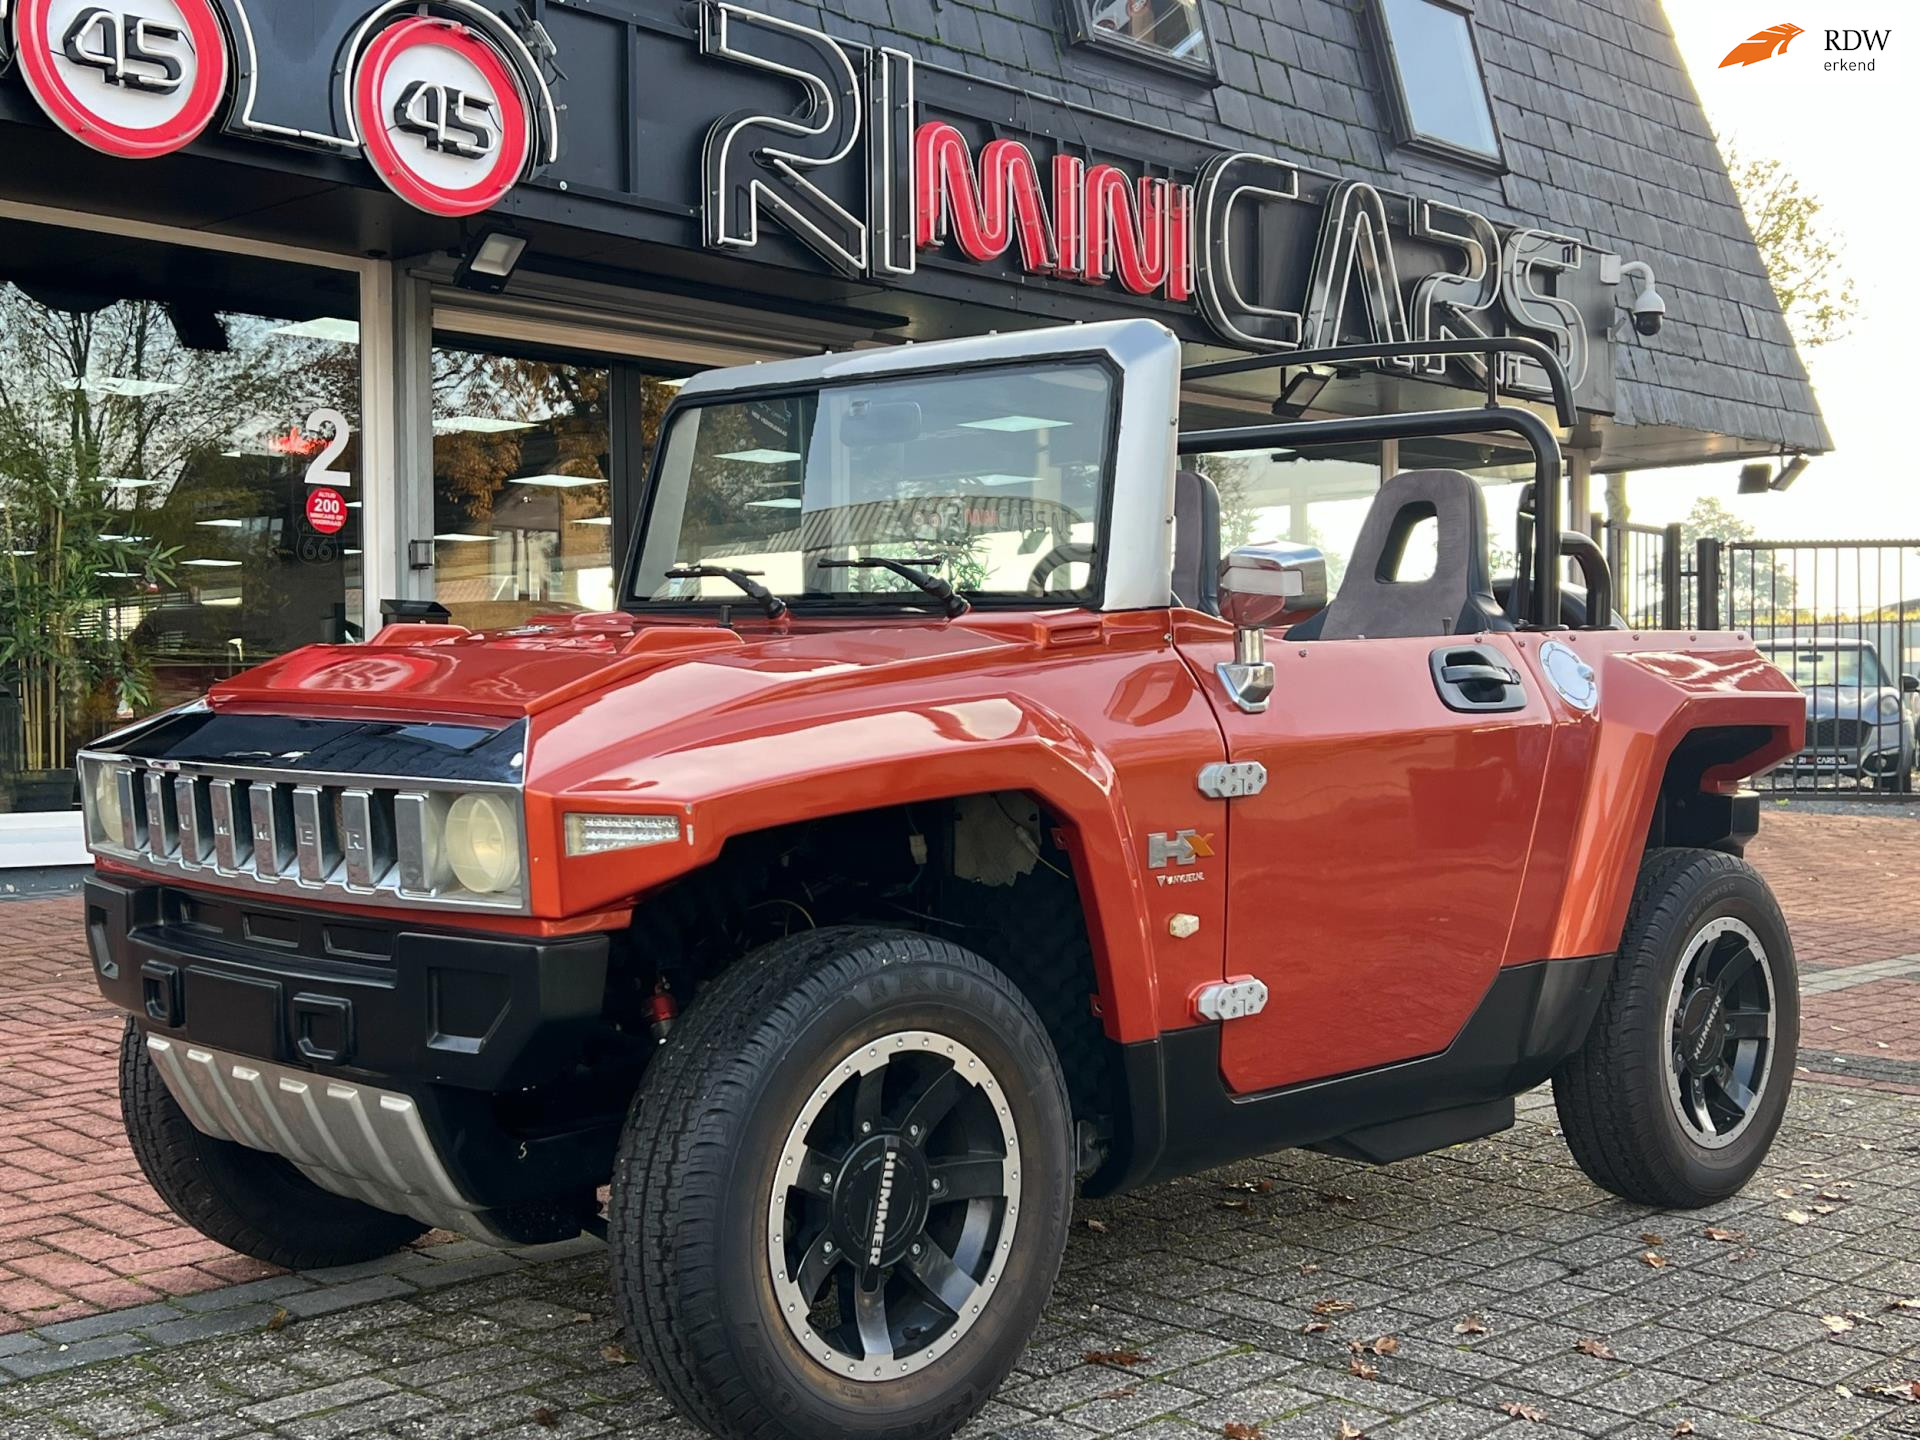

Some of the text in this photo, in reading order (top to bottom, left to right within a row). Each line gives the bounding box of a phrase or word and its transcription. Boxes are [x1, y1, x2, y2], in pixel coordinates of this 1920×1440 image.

[62, 7, 187, 95] 45
[393, 80, 497, 160] 45
[304, 408, 351, 487] 2
[314, 497, 340, 514] 200
[1693, 994, 1723, 1061] HUMMER
[868, 1151, 898, 1267] HUMMER
